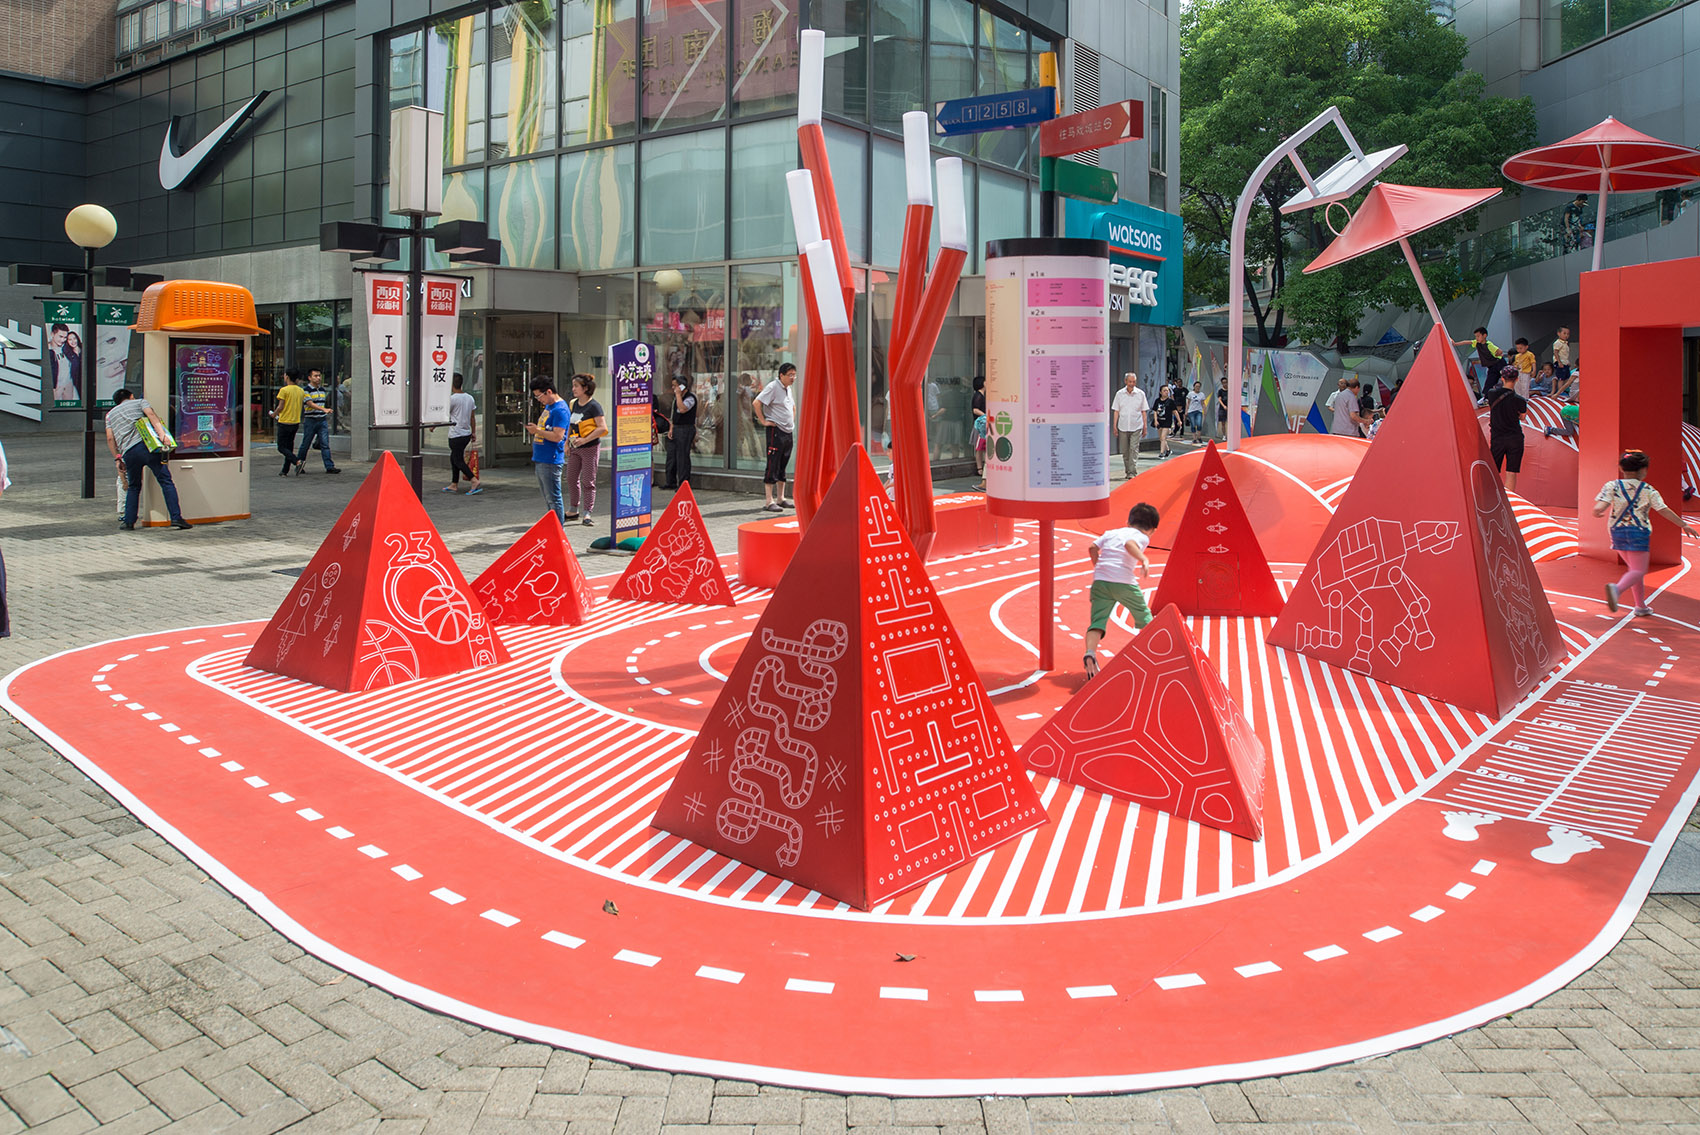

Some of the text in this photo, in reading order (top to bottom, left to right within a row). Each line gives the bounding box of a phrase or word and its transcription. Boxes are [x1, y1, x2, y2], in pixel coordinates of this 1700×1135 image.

[1108, 221, 1162, 252] watsons
[376, 286, 400, 301] 西贝
[431, 287, 453, 301] 西贝
[384, 530, 436, 568] 23
[1475, 767, 1526, 783] 0.5m
